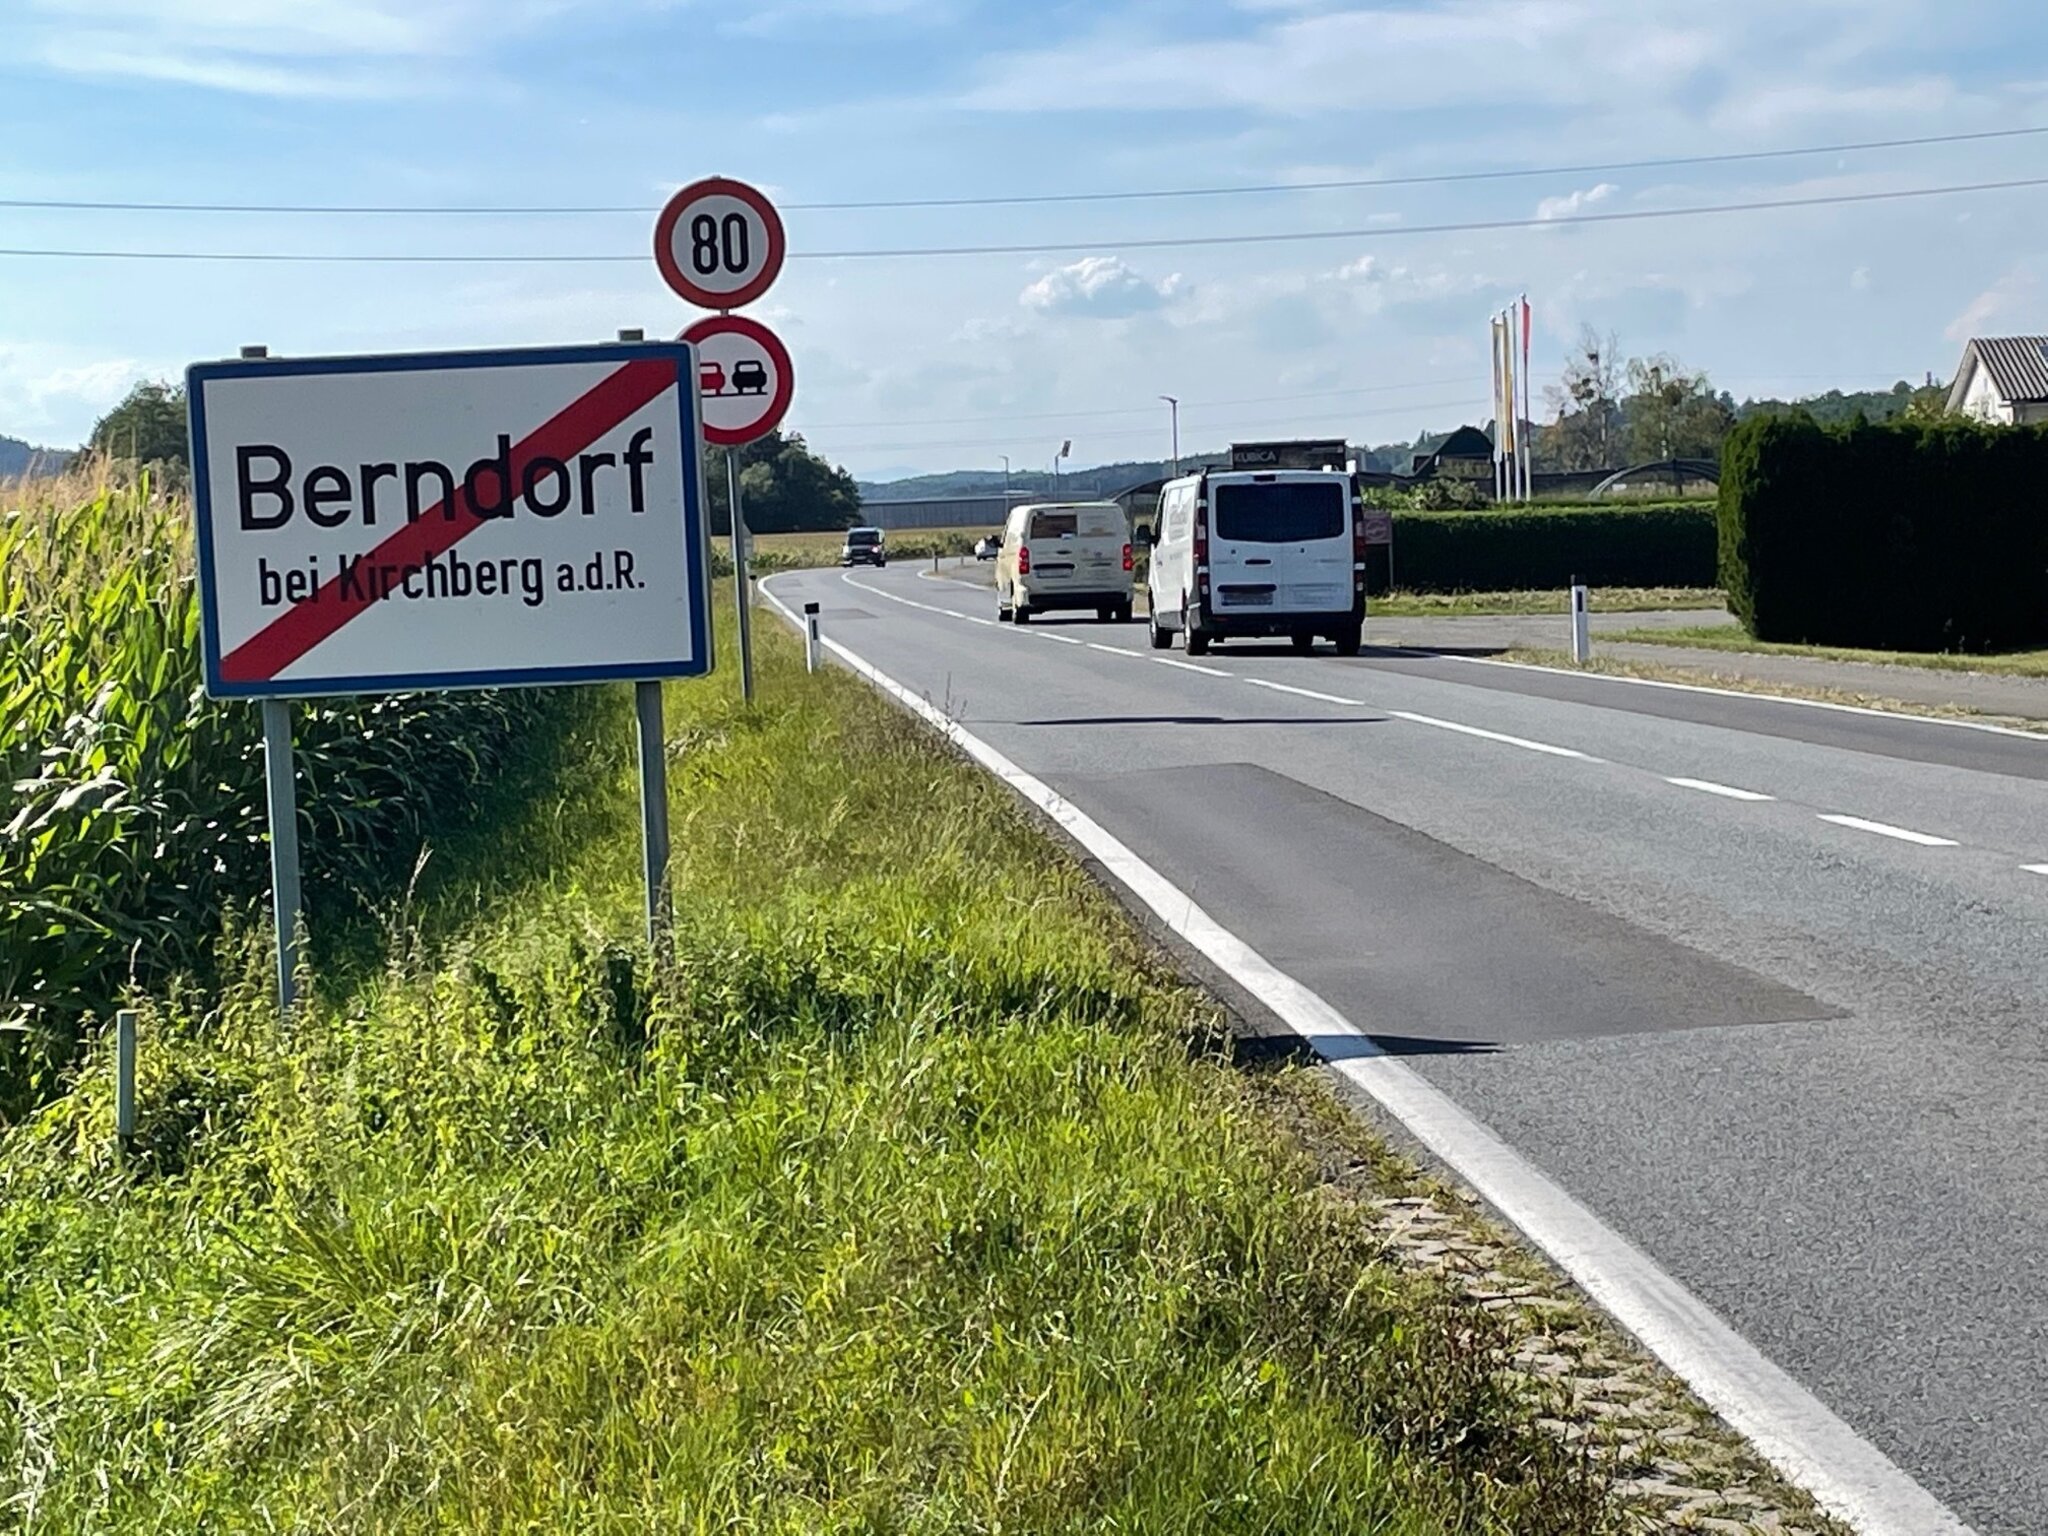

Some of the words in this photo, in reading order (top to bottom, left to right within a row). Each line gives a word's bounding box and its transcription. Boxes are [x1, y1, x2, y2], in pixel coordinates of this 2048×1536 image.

[692, 213, 750, 275] 80
[236, 427, 654, 531] Berndorf
[259, 556, 318, 606] bei
[339, 550, 544, 607] Kirchberg
[557, 551, 645, 592] a.d.R.
